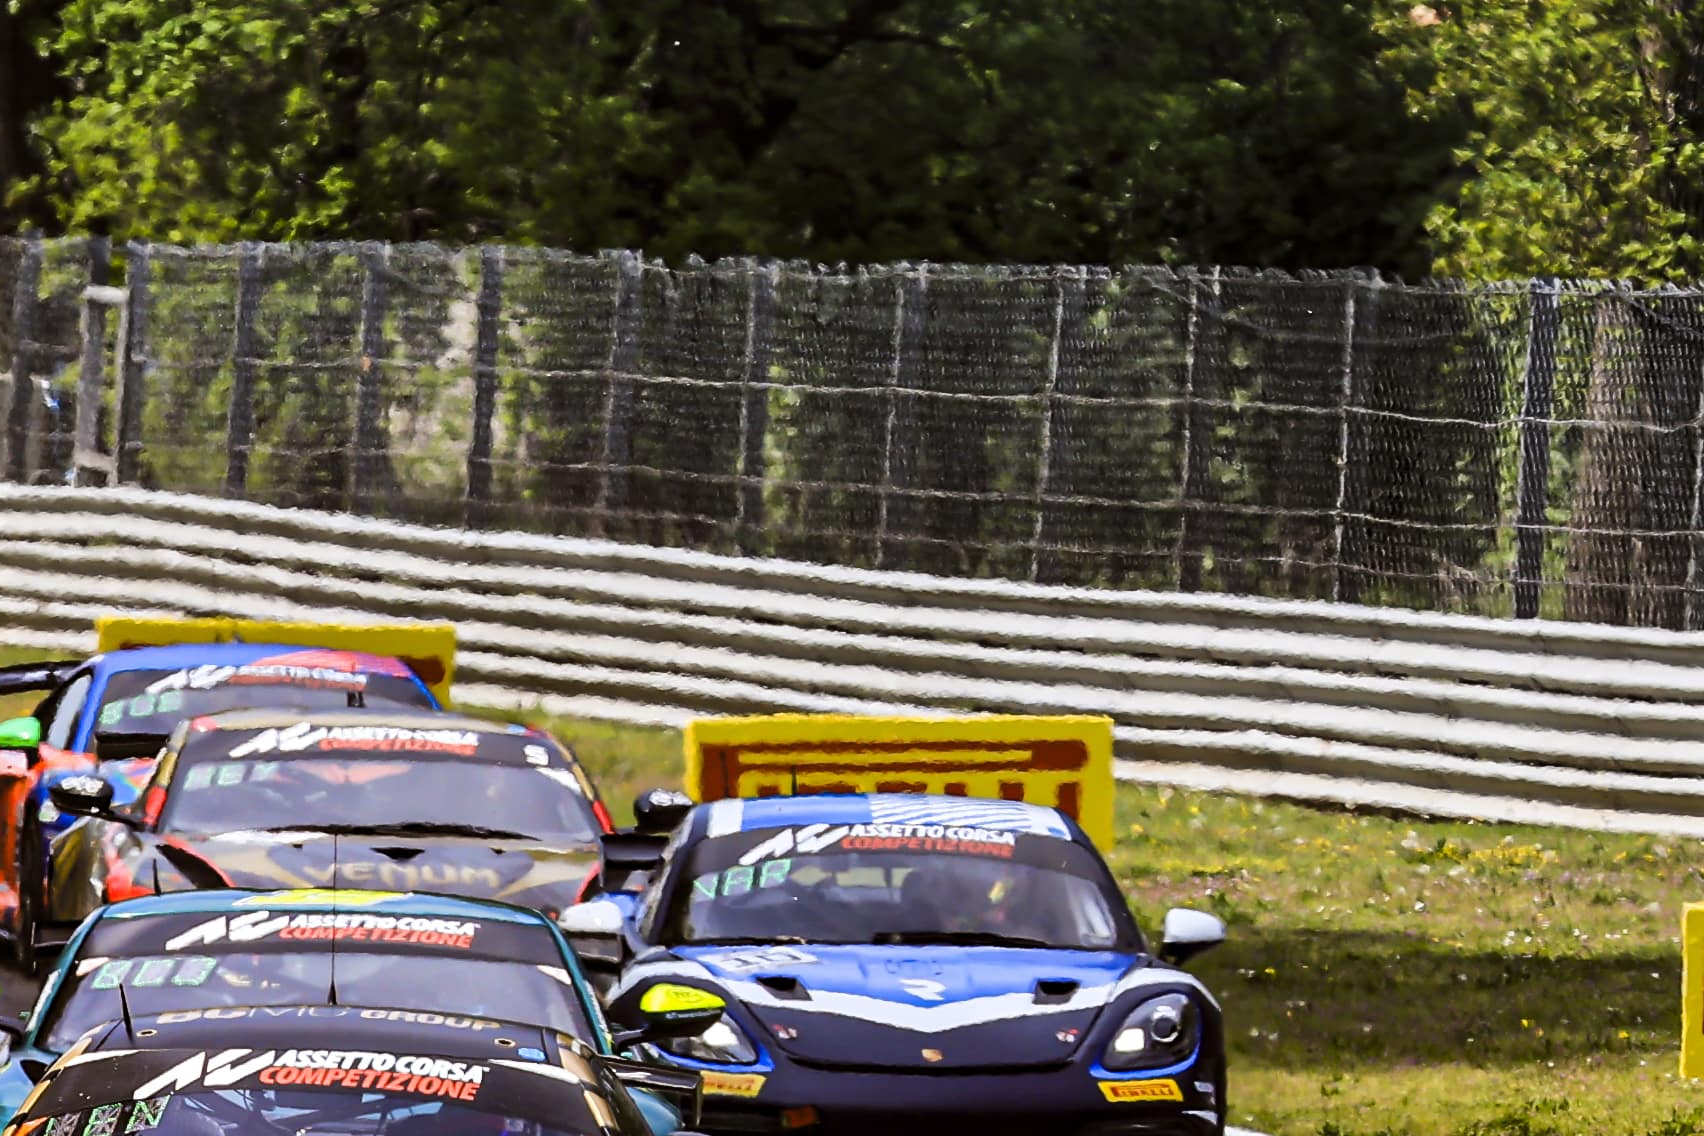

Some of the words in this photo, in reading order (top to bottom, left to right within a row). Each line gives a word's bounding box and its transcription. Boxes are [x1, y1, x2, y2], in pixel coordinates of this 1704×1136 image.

[327, 727, 414, 741] ASSETTO
[415, 731, 479, 745] CORSA
[850, 824, 944, 838] ASSETTO
[946, 827, 1016, 845] CORSA
[841, 836, 1014, 858] COMPETIZIONE
[301, 862, 502, 890] VENUM
[289, 913, 397, 930] ASSETTO
[397, 917, 475, 936] CORSA
[279, 926, 474, 948] COMPETIZIONE
[358, 1009, 504, 1031] GROUP
[274, 1049, 395, 1073] ASSETTO
[396, 1056, 484, 1083] CORSA
[259, 1066, 481, 1101] COMPETIZIONE
